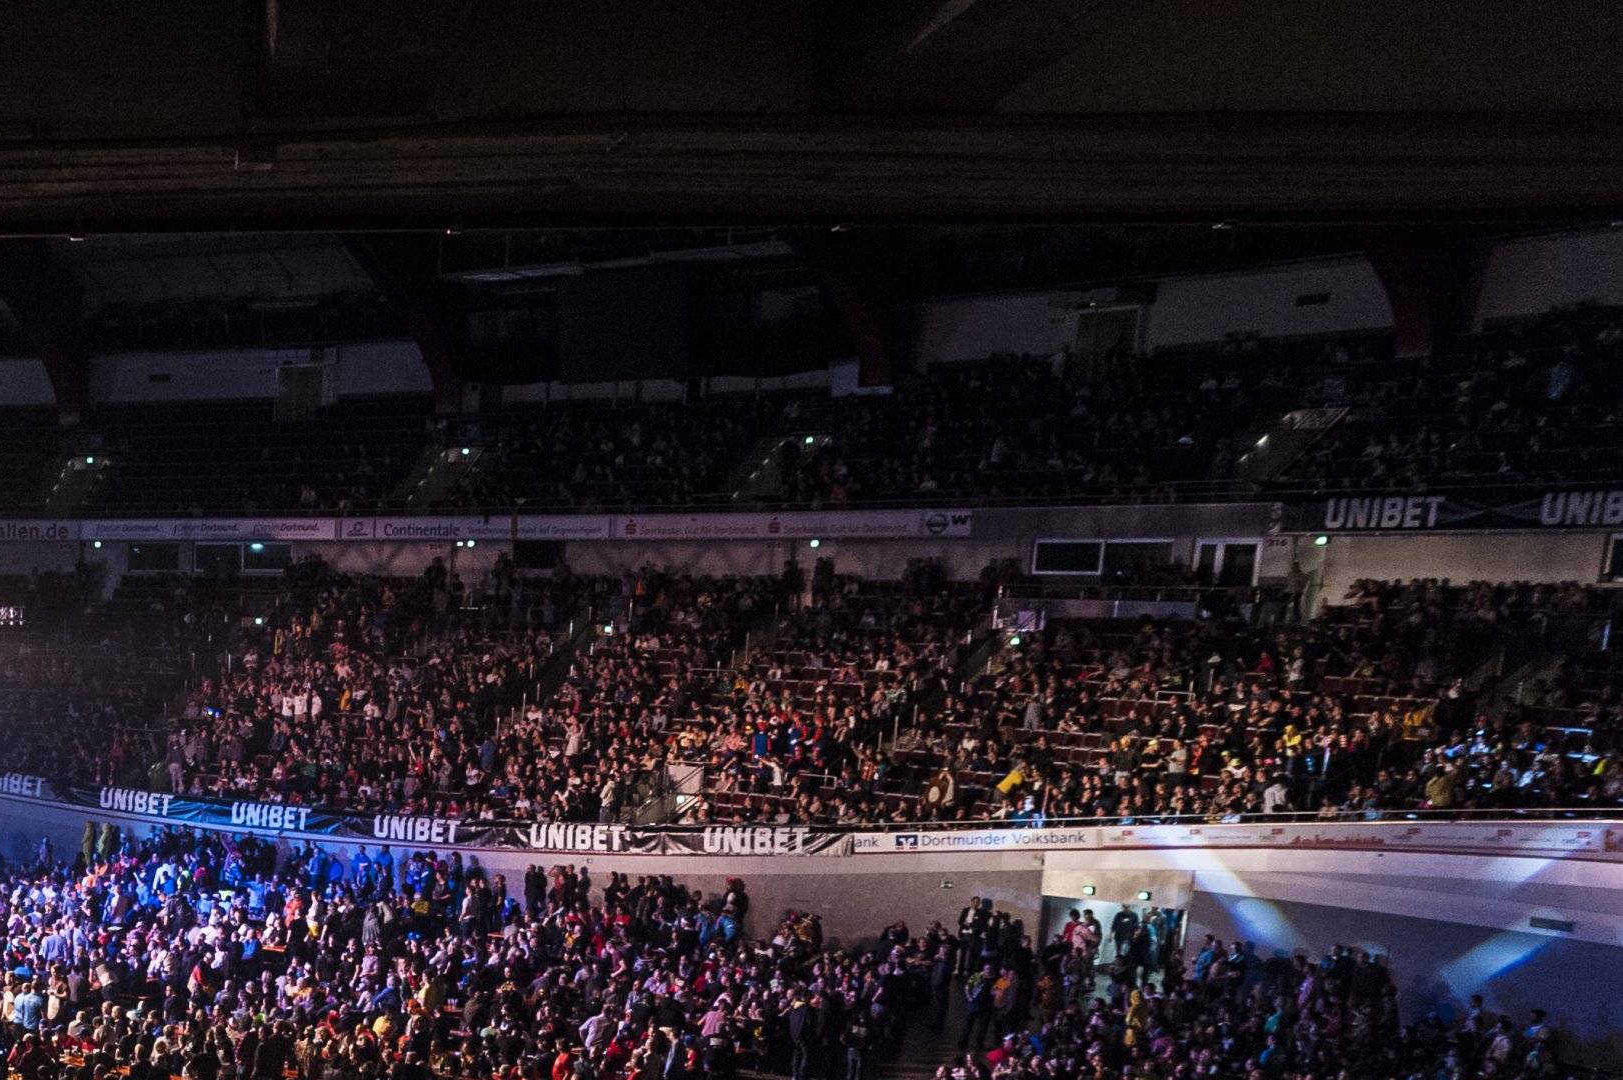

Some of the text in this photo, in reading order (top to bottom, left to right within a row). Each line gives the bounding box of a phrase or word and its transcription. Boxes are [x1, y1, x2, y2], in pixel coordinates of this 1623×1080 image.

[1325, 495, 1446, 529] UNIBET
[1539, 490, 1623, 526] UNIB
[384, 523, 459, 537] Continentale
[100, 786, 175, 817] UNIBET
[231, 801, 313, 831] UNIBET
[373, 814, 463, 844] UNIBET
[529, 822, 626, 851] UNIBET
[703, 826, 810, 853] UNIBET
[921, 831, 1086, 847] Dortmunder Volksbank
